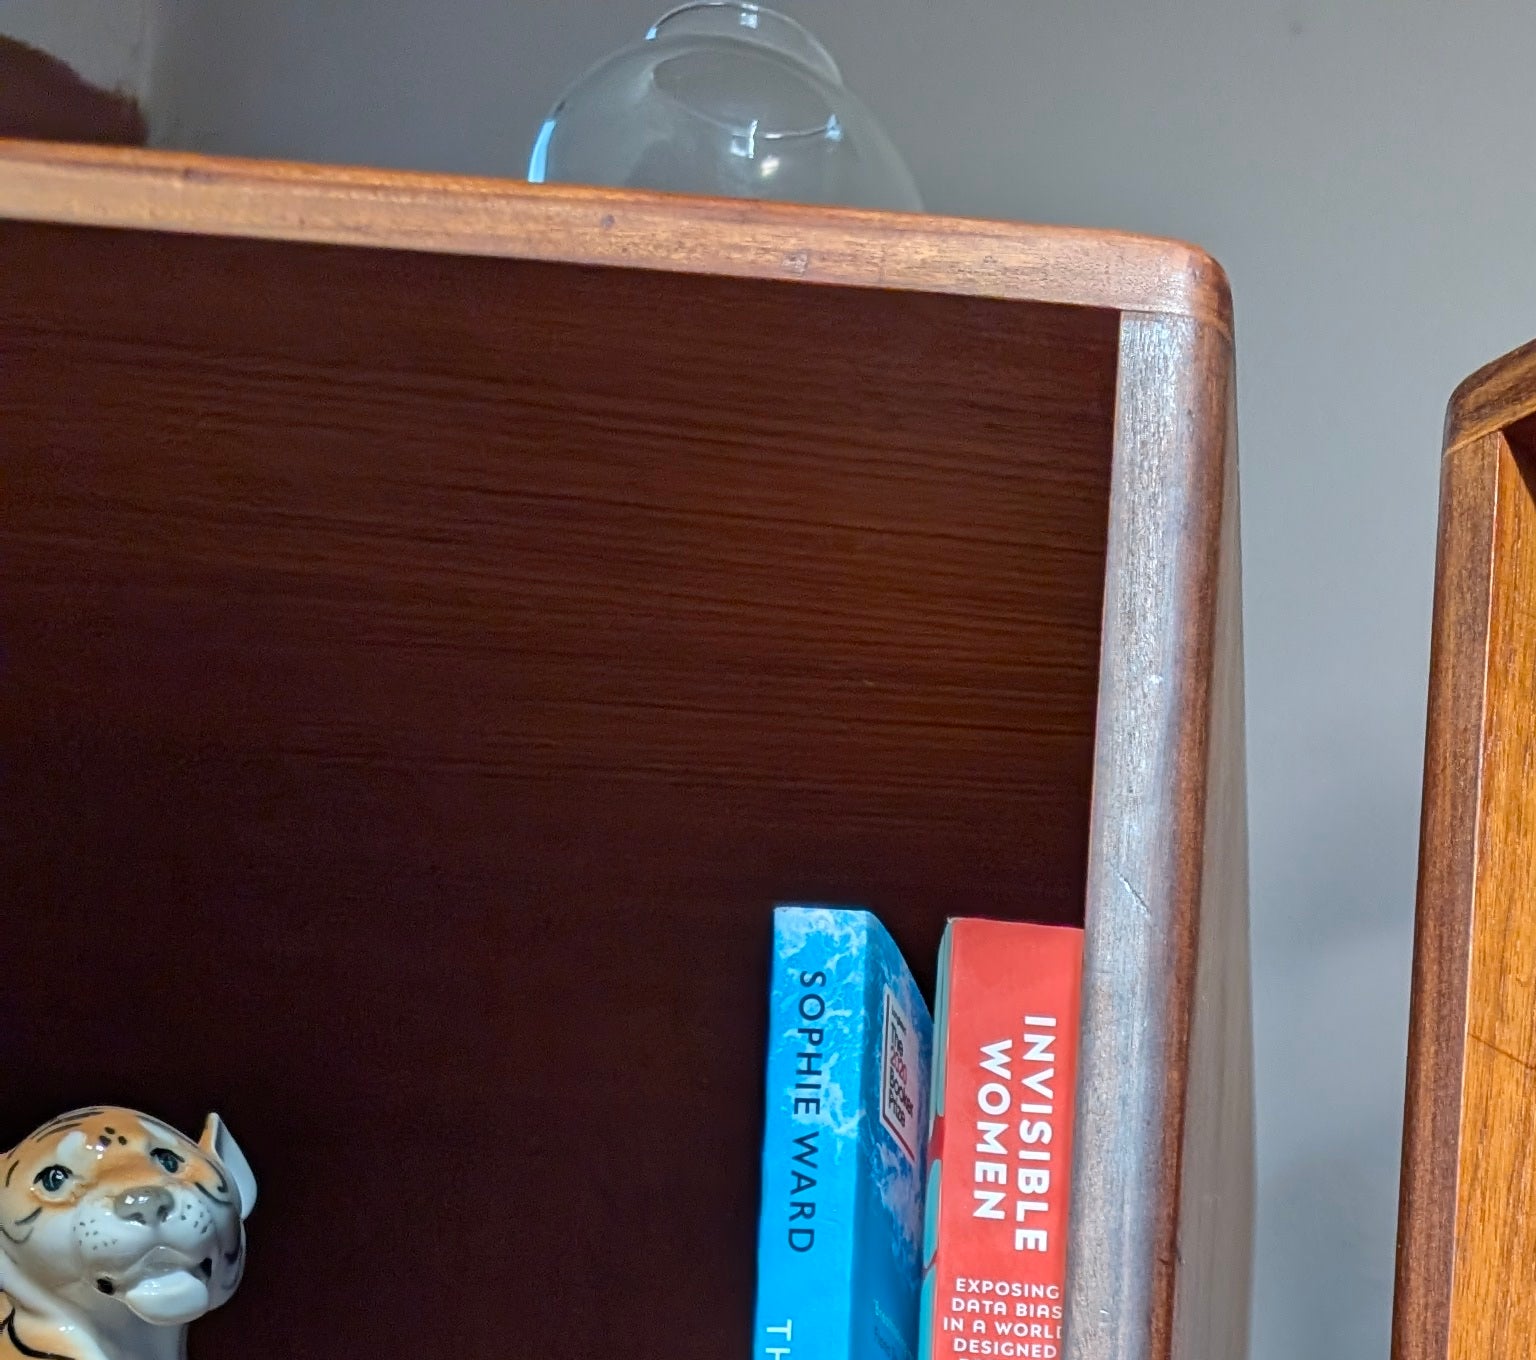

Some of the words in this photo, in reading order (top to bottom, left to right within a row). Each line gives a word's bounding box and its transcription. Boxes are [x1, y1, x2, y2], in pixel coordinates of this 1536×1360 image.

[793, 970, 826, 1115] SOPHIE
[972, 1039, 1012, 1219] WOMEN
[1014, 1015, 1056, 1251] INVISIBLE
[788, 1131, 820, 1253] WARD
[951, 1297, 1007, 1315] DATA
[1015, 1303, 1062, 1319] BIAS
[955, 1278, 1060, 1299] EXPOSING
[943, 1317, 964, 1332] IN
[972, 1319, 986, 1334] A
[953, 1337, 1057, 1358] DESIGNED
